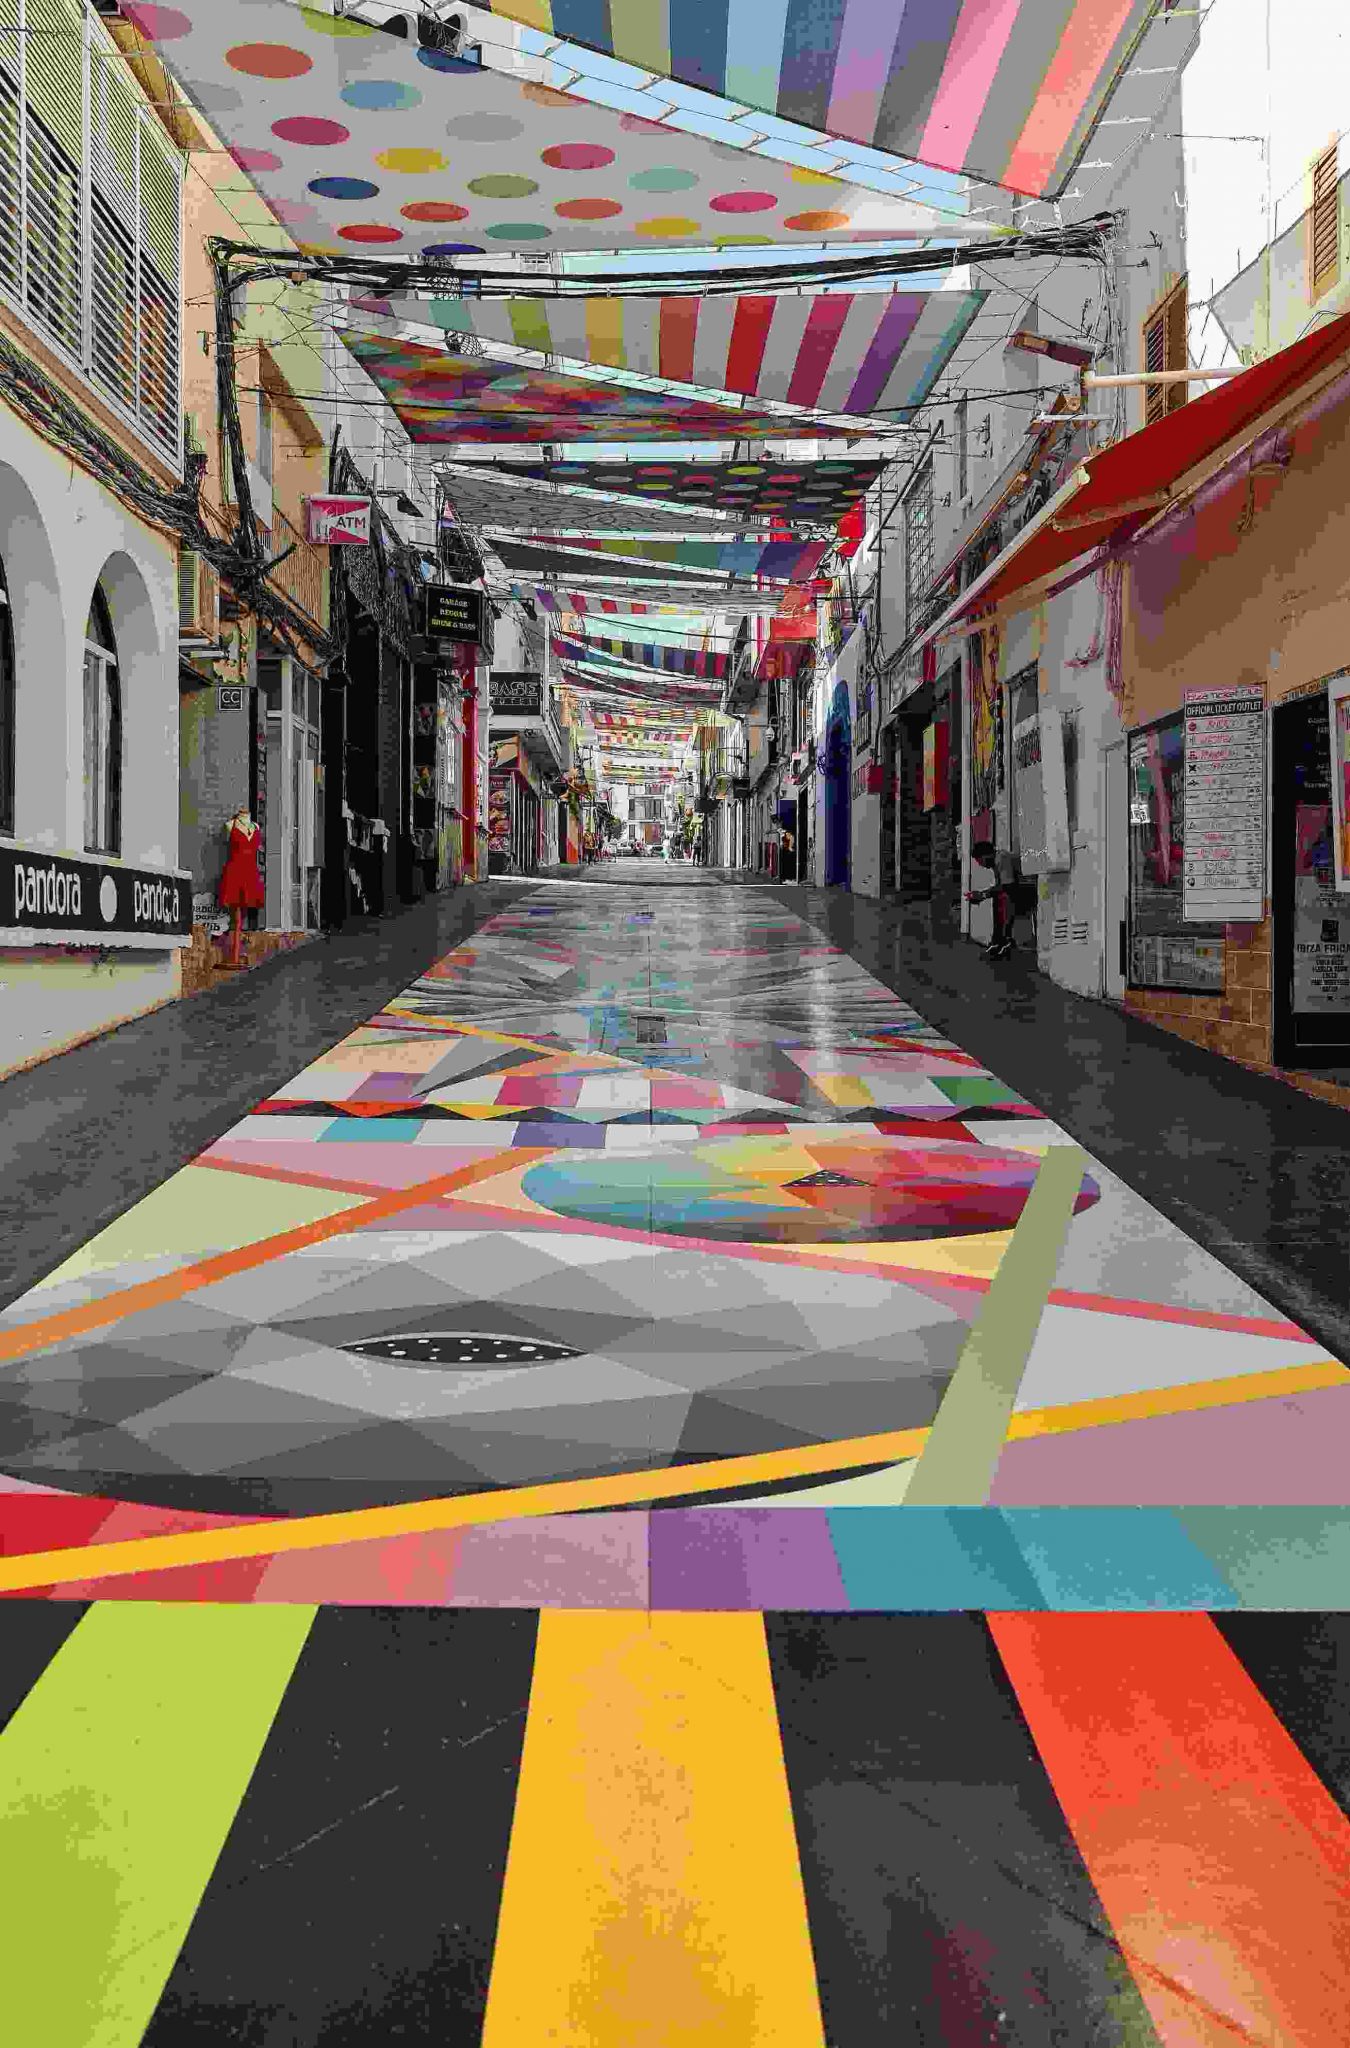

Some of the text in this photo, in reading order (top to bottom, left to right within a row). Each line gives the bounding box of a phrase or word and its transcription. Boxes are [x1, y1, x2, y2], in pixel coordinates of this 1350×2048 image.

[335, 516, 366, 529] ATM
[489, 681, 538, 697] BASE
[1187, 701, 1262, 716] OFFICIAL TICKET OUTLET
[14, 863, 82, 919] pandora
[1297, 943, 1321, 953] IBIZA
